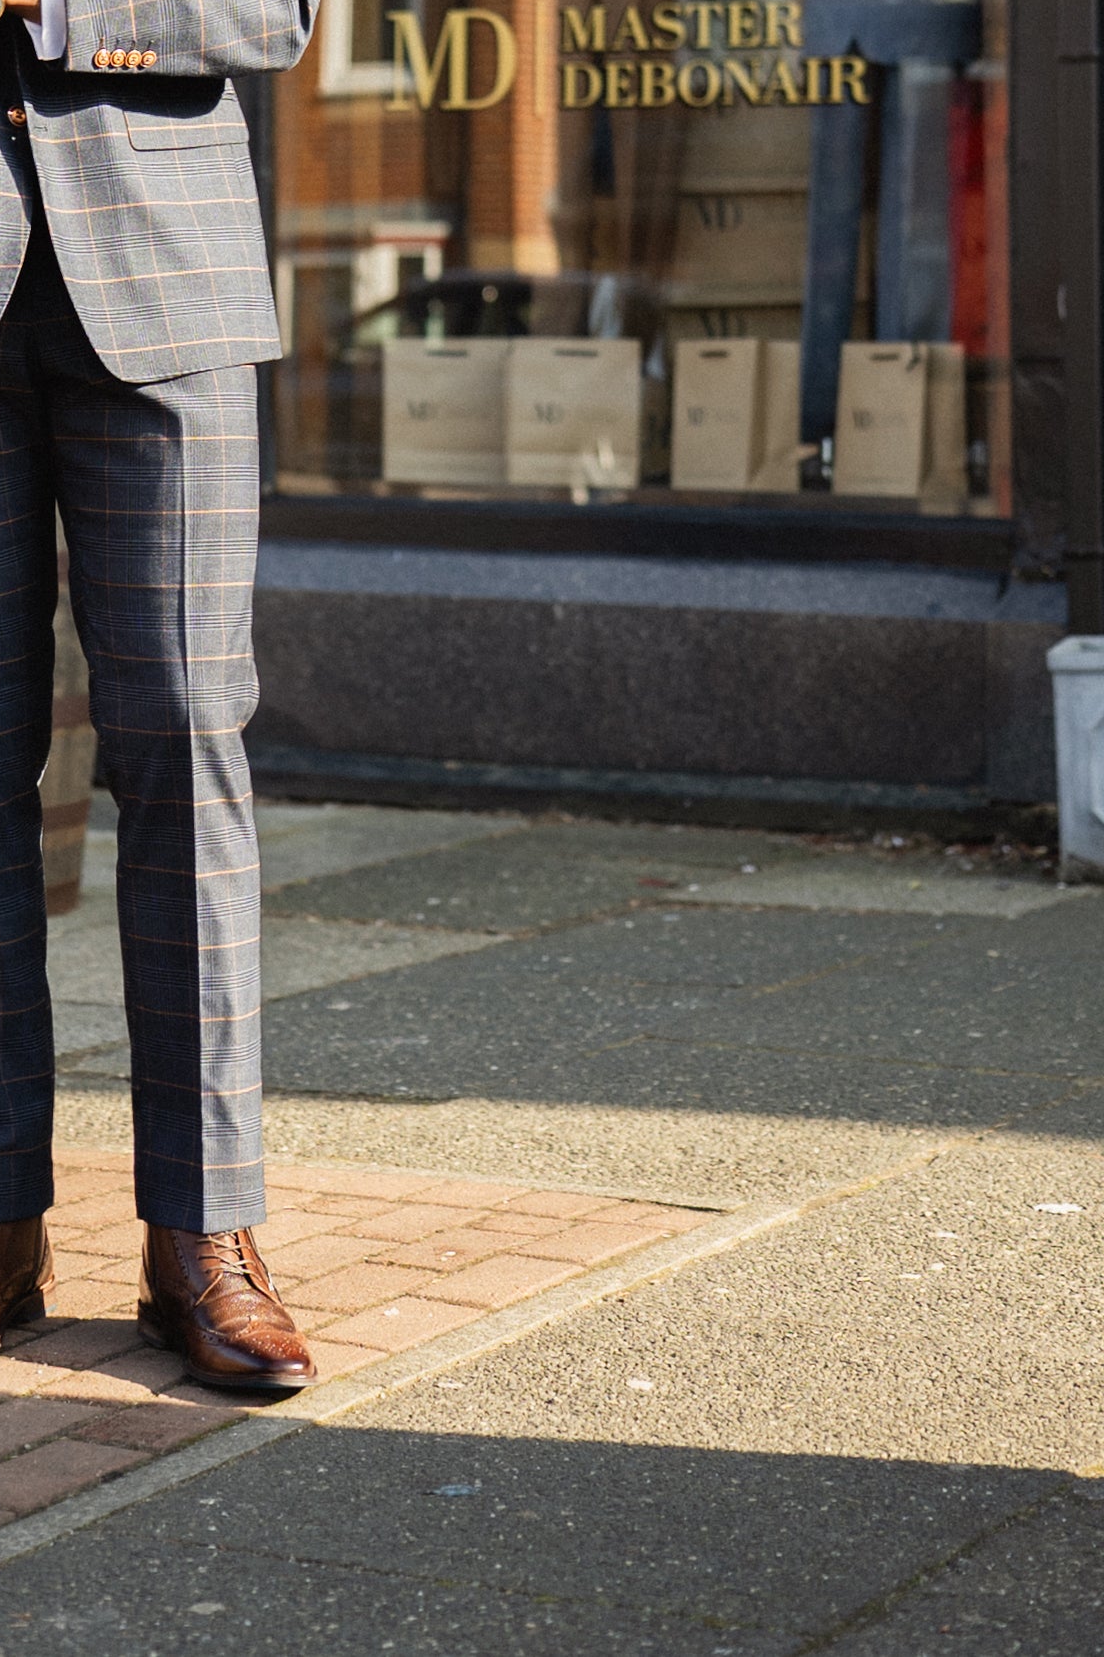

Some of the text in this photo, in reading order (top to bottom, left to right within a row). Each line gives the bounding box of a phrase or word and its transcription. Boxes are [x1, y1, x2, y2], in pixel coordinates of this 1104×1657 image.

[559, 0, 804, 52] MASTER
[385, 6, 519, 112] MD
[560, 54, 873, 110] DEBONAIR
